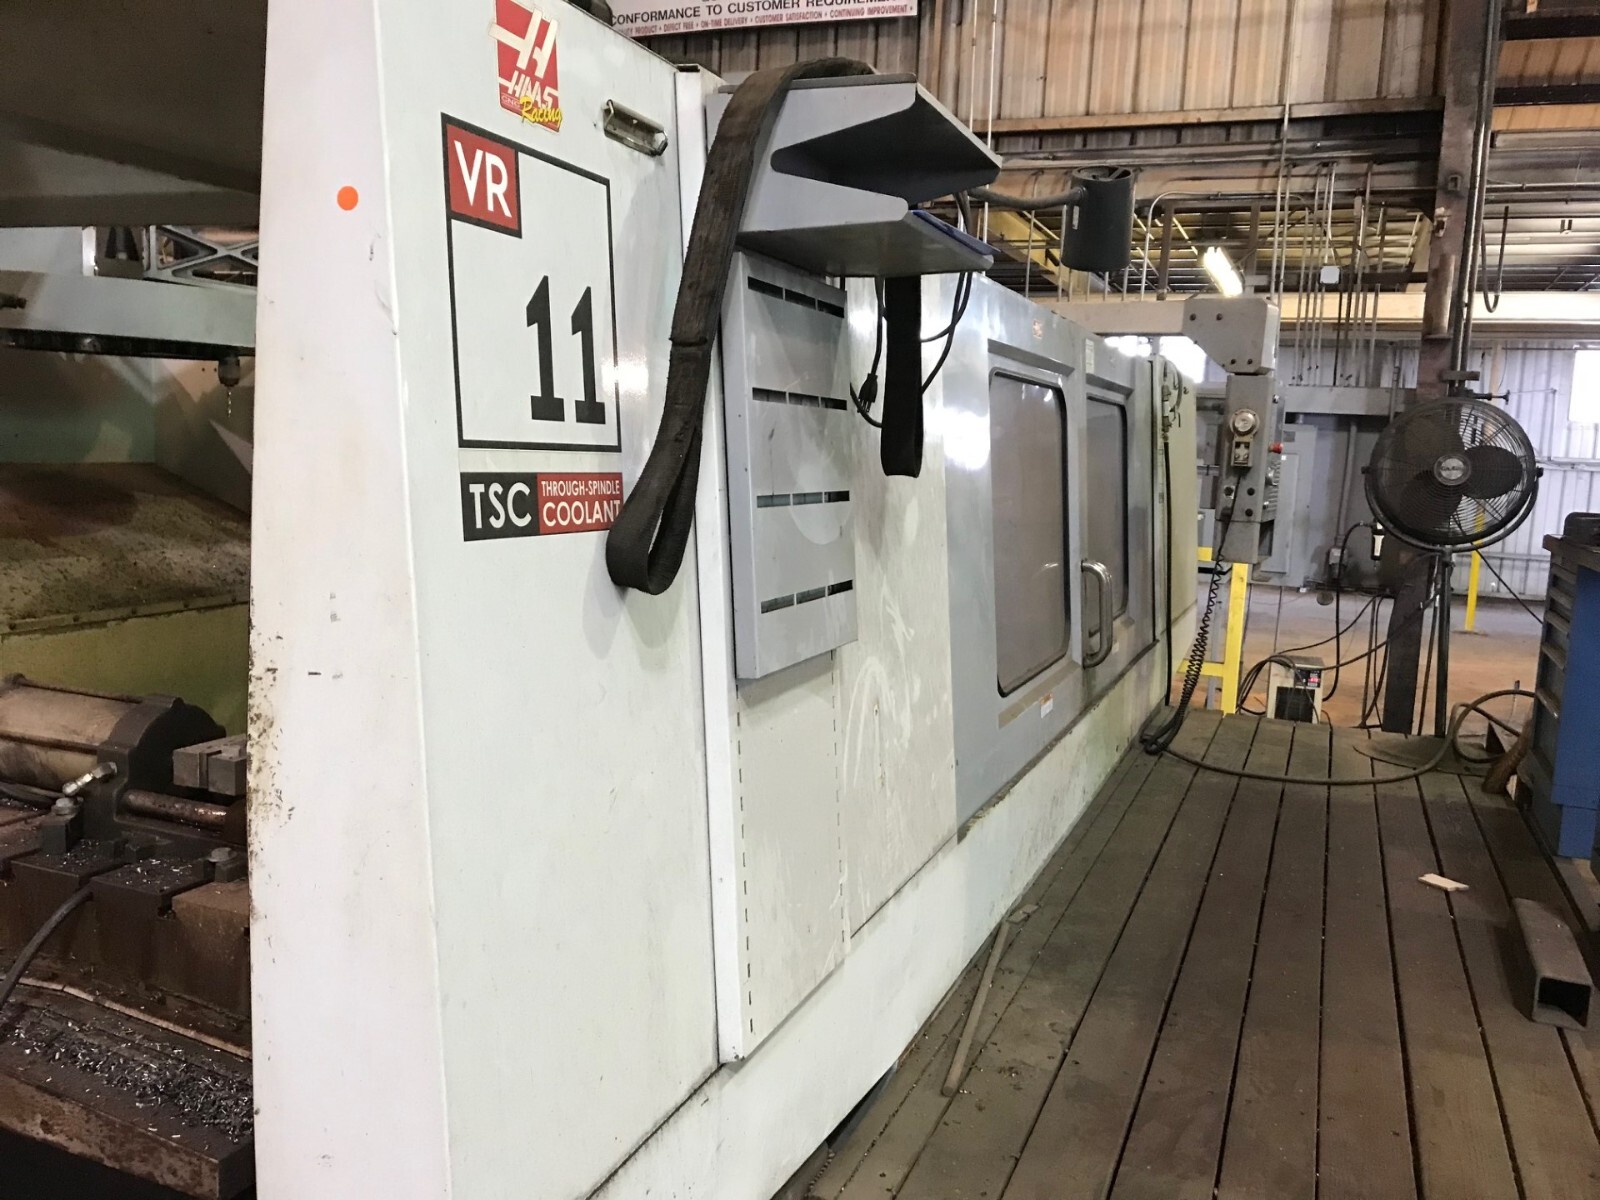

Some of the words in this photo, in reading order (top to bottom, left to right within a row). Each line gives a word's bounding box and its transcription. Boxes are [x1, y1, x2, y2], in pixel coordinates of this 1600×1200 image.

[611, 6, 701, 26] CONFORMANCE
[706, 4, 722, 15] TO
[728, 0, 799, 14] CUSTOMER
[701, 19, 722, 28] ON-TIME
[724, 17, 747, 26] DELIVERY
[755, 13, 783, 24] CUSTOMER
[786, 11, 822, 21] SATISFACTION
[830, 7, 864, 18] CONTINUING
[867, 4, 907, 15] IMPROVEMENT
[497, 70, 559, 109] HAAS
[520, 95, 563, 127] Racing
[454, 140, 512, 218] VR
[526, 275, 606, 424] 11
[541, 480, 620, 496] THROUGH-SPINDLE
[469, 481, 532, 529] TSC
[543, 499, 620, 527] COOLANT
